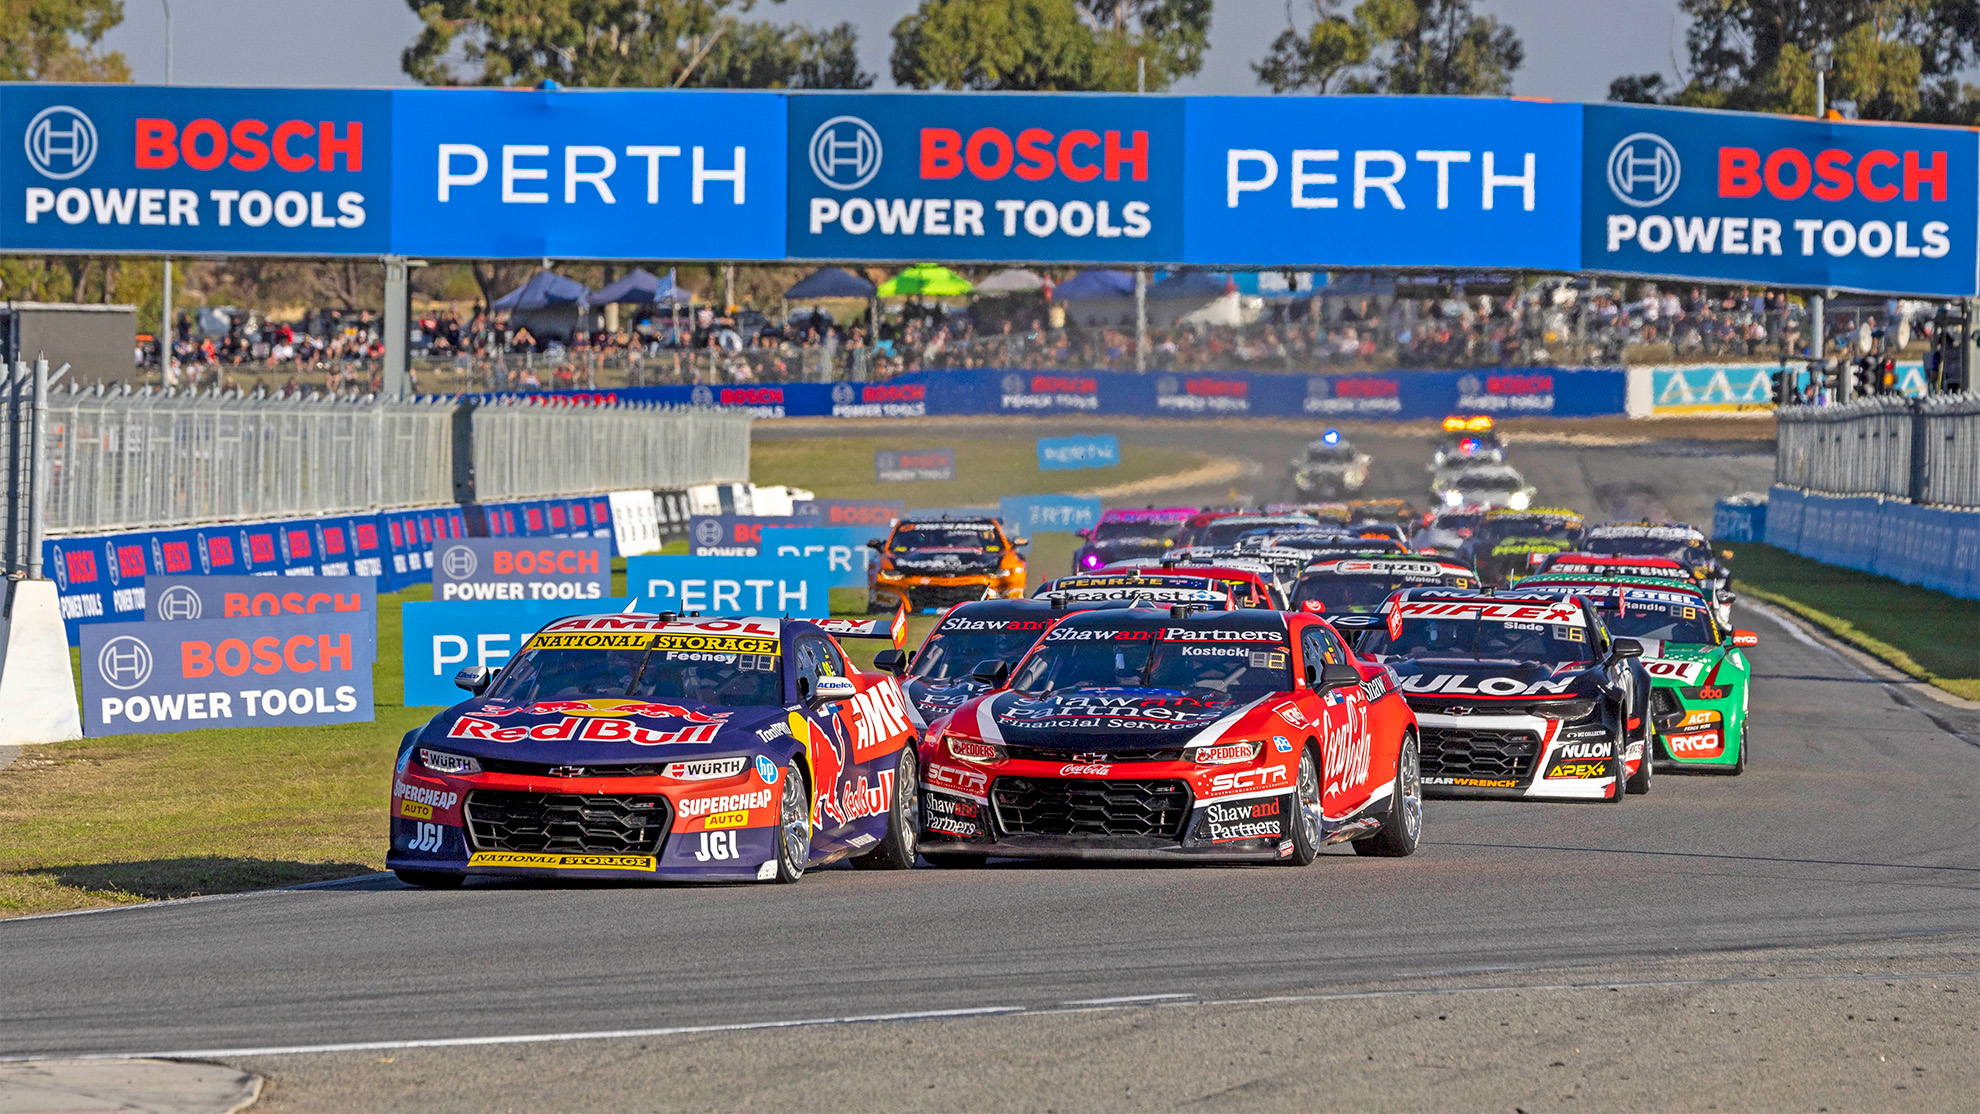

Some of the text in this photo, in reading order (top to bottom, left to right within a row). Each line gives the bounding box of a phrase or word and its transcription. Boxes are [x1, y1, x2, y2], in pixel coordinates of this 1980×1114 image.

[135, 118, 363, 172] BOSCH
[919, 127, 1149, 182] BOSCH
[437, 143, 747, 205] PERTH
[1226, 149, 1535, 211] PERTH
[1718, 146, 1948, 202] BOSCH
[25, 187, 366, 228] POWER TOOLS
[809, 198, 1151, 238] POWER TOOLS
[1606, 214, 1951, 258] POWER TOOLS
[720, 388, 784, 405] BOSCH
[862, 384, 926, 403] BOSCH
[829, 505, 898, 526] BOSCH
[117, 545, 147, 577] BOSCH
[162, 541, 192, 573] BOSCH
[493, 550, 599, 574] BOSCH
[65, 550, 98, 584] BOSCH
[1372, 563, 1432, 572] ENZED
[1593, 565, 1691, 579] BTTERIES
[1405, 575, 1442, 585] Waters
[113, 587, 146, 613] POWER TOO
[443, 582, 601, 600] POWER TOOLS
[648, 579, 808, 612] PERTH
[1047, 590, 1184, 601] Seadfast
[1631, 590, 1695, 604] STEEL
[60, 593, 103, 620] POWER TOOLS
[224, 592, 361, 618] BOSCH
[1401, 603, 1575, 622] HIFLEX
[1624, 602, 1666, 613] Randle
[545, 618, 776, 636] AMPOL
[1504, 621, 1544, 631] Slade
[533, 634, 773, 653] NATIONAL STORAGE
[1734, 635, 1757, 644] RYCO
[181, 633, 352, 679] BOSCH
[666, 651, 737, 664] Feeney
[1182, 646, 1249, 658] Kostecki
[817, 682, 853, 690] ACDelco
[1700, 685, 1722, 699] dba
[101, 685, 358, 724] POWER TOOLS
[1001, 706, 1222, 722] Partners
[998, 718, 1212, 731] Financial Services
[1688, 712, 1712, 723] ACT
[447, 716, 726, 746] Red Bull
[961, 742, 995, 758] PEDDERS
[1210, 745, 1252, 760] PEDDERS
[1561, 742, 1611, 758] NULON
[1671, 734, 1719, 752] RYCO
[760, 758, 774, 783] hp
[928, 763, 987, 790] SCTR
[1211, 765, 1287, 792] SCTR
[393, 781, 458, 810] SUPERCHEAP
[678, 788, 772, 818] SUPERCHEAP
[404, 803, 430, 816] AUTO
[709, 813, 744, 825] AUTO
[926, 810, 976, 835] Partners
[1209, 820, 1281, 840] Partners
[694, 830, 740, 862] JGI
[471, 854, 647, 867] NATIONAL STORAGE
